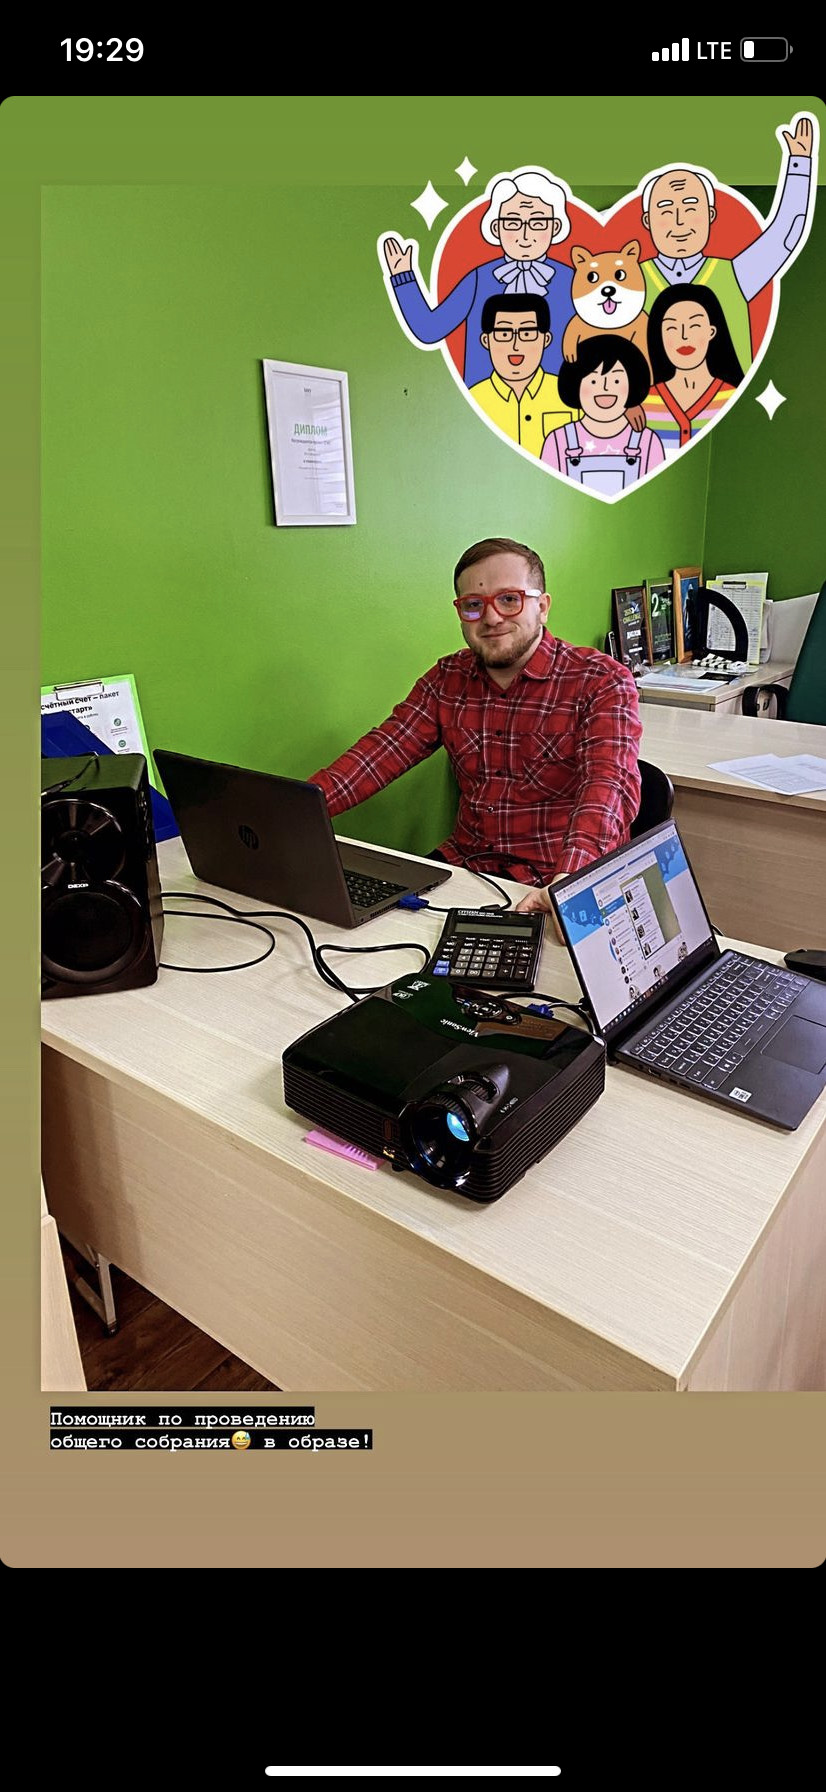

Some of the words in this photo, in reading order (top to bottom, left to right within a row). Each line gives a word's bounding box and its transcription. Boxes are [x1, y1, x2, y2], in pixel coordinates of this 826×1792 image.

[294, 423, 328, 436] ДИПЛОМ
[99, 691, 119, 699] пакет
[69, 706, 93, 714] тарт»
[440, 1018, 479, 1038] ViewSonic
